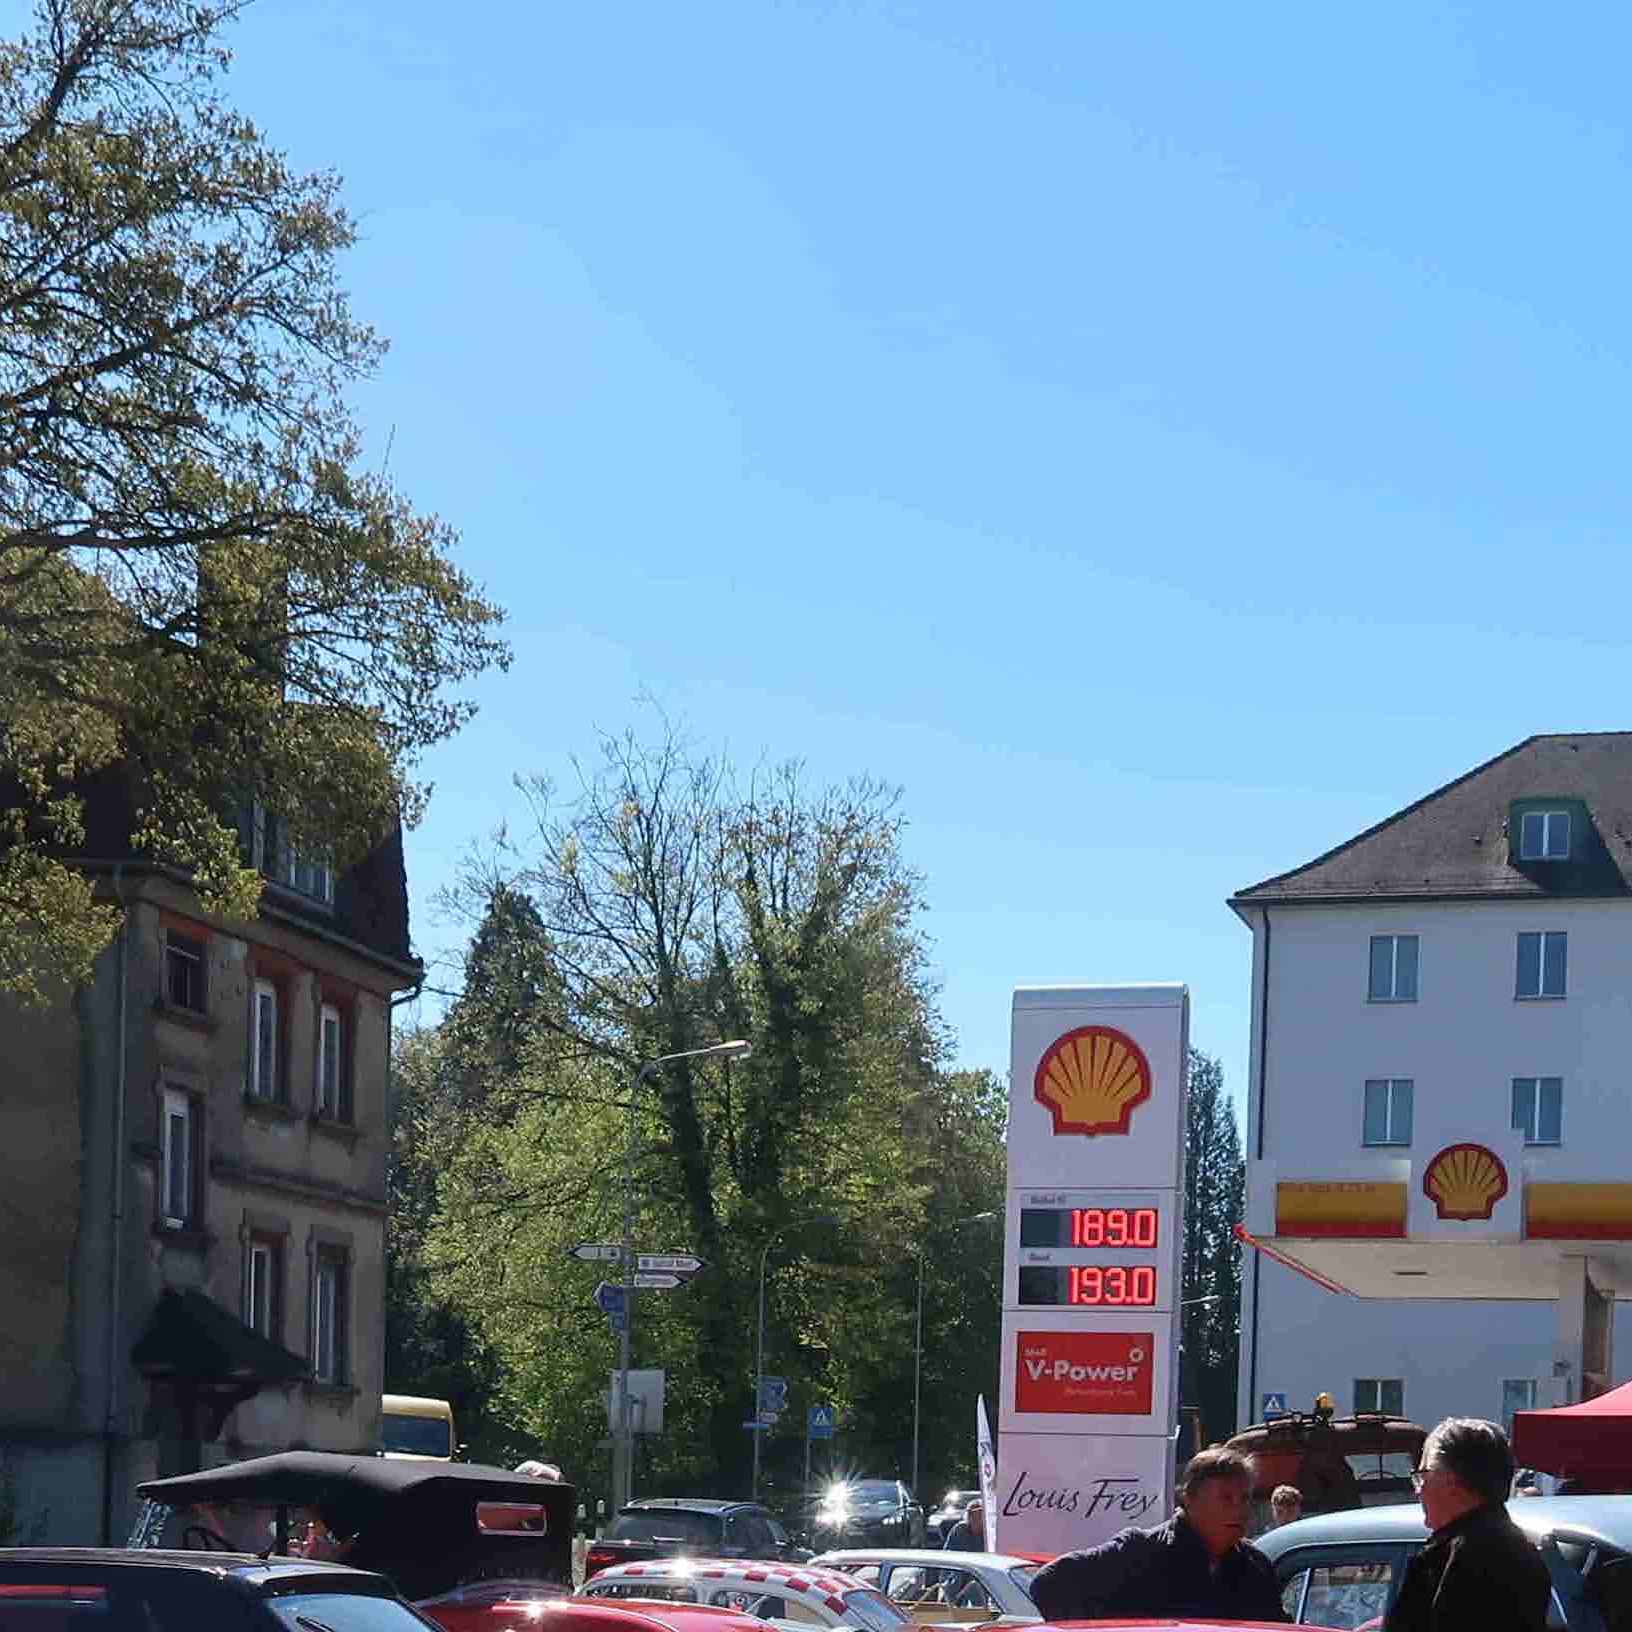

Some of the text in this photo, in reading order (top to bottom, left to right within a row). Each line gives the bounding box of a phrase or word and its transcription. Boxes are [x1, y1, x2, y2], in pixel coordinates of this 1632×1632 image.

[1070, 1209, 1156, 1246] 189.0
[1070, 1266, 1155, 1304] 193.0
[1023, 1359, 1140, 1382] V-Power
[1002, 1471, 1080, 1517] Louis
[1084, 1477, 1159, 1520] Frey
